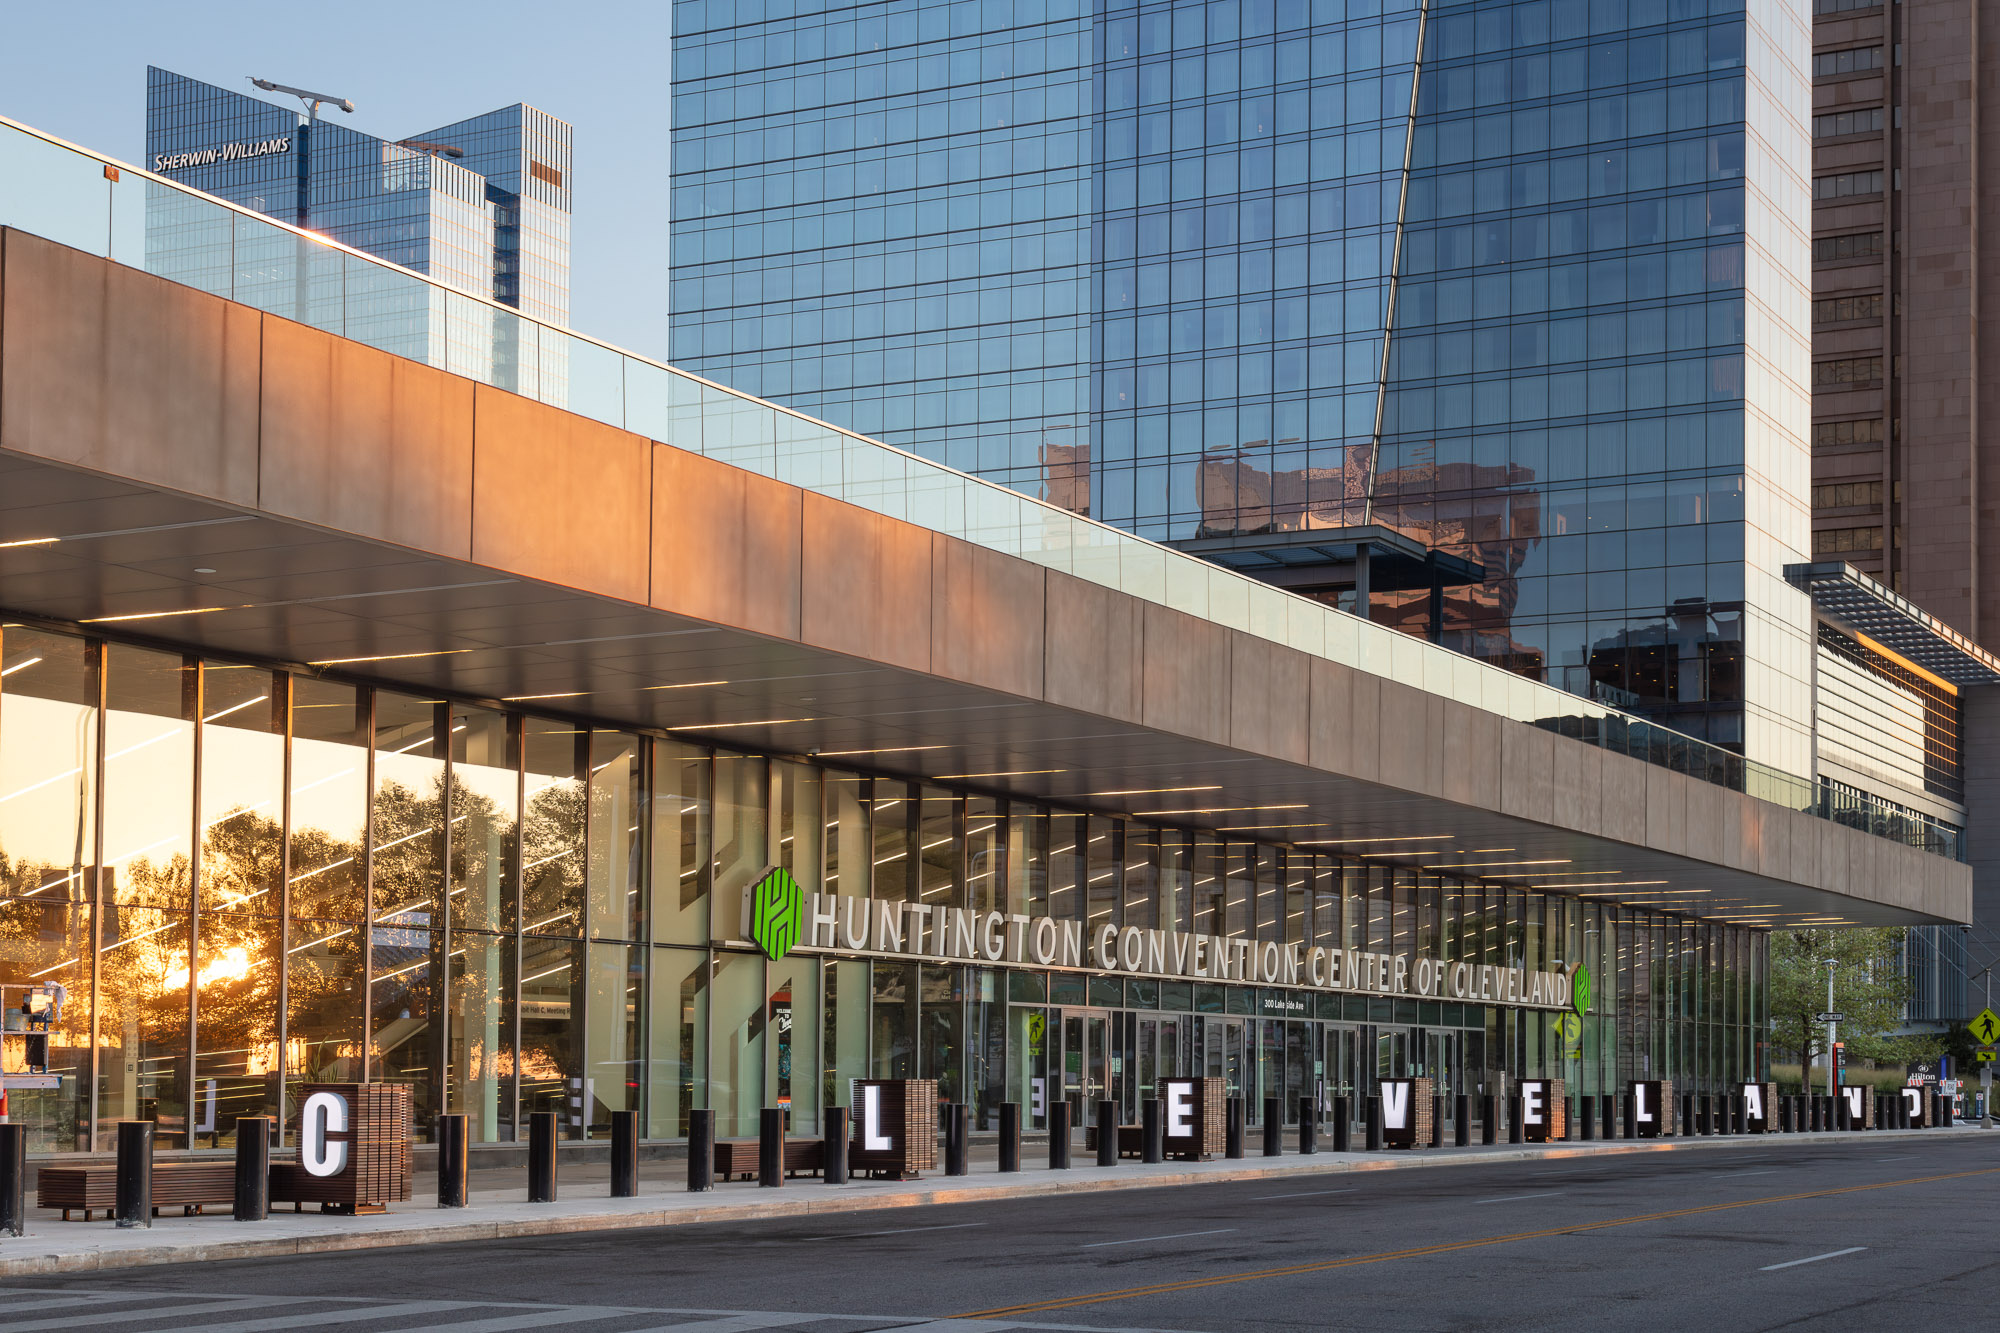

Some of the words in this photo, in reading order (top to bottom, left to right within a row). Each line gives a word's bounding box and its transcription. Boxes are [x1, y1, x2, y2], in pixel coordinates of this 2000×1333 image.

[154, 138, 290, 172] SHERWIN-WILLIAMS
[810, 892, 1082, 967] HUNTINGTON
[1100, 923, 1299, 985] CONVENTION
[1312, 946, 1408, 994] CENTER
[1418, 957, 1446, 996] OF
[1455, 962, 1568, 1006] CLEVELAND
[1264, 999, 1274, 1008] 300
[1295, 1002, 1304, 1010] Ave
[1911, 1072, 1936, 1081] Hilton
